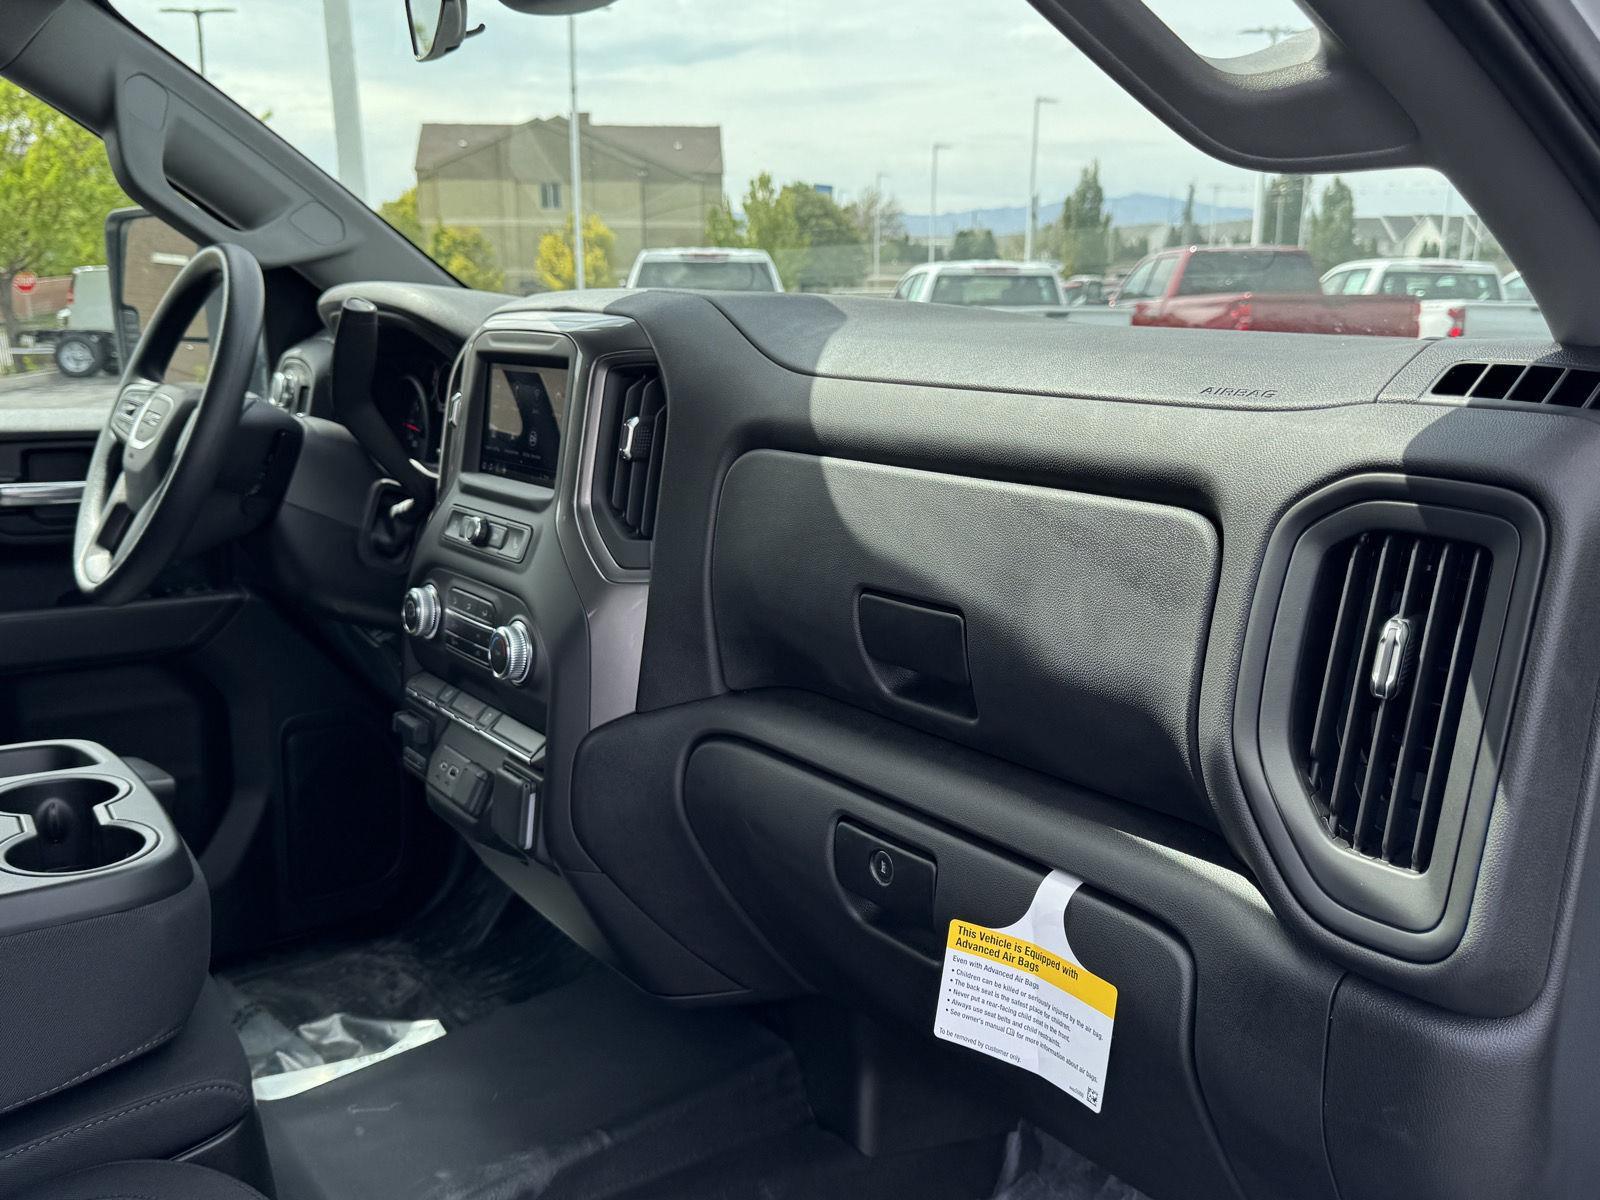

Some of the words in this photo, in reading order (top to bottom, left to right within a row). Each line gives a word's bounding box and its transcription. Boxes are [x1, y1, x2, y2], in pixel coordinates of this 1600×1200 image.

[1200, 387, 1278, 399] AIRBAG
[953, 955, 967, 964] Even
[969, 961, 982, 969] with
[984, 965, 1014, 980] Advanced
[1015, 975, 1024, 983] Air
[1025, 979, 1039, 990] Bags
[956, 938, 1000, 958] Advanced
[1002, 952, 1016, 963] Air
[1018, 957, 1039, 972] Bags
[959, 926, 977, 938] This
[980, 931, 1012, 949] Vehicle
[1014, 942, 1022, 953] is
[1025, 946, 1060, 970] Equipped
[1062, 966, 1078, 980] with
[951, 999, 971, 1010] Always
[984, 1010, 997, 1019] seat
[997, 1014, 1011, 1024] belts
[1012, 1020, 1023, 1029] and
[1024, 1024, 1037, 1034] child
[1038, 1031, 1061, 1048] restraints.
[953, 989, 969, 999] Never
[971, 995, 980, 1003] put
[986, 1000, 1017, 1016] rear-facing
[1018, 1011, 1031, 1021] child
[1033, 1018, 1044, 1027] seat
[1058, 1031, 1070, 1043] front.
[955, 979, 965, 987] The
[967, 983, 980, 991] back
[981, 988, 993, 996] seat
[1001, 994, 1010, 1002] the
[1011, 999, 1028, 1009] safest
[1029, 1005, 1043, 1016] place
[1051, 1016, 1070, 1032] children.
[956, 969, 980, 981] Children
[994, 981, 1001, 989] be
[1003, 984, 1019, 994] killed
[1028, 994, 1051, 1010] seriously
[1052, 1005, 1068, 1019] injured
[1070, 1015, 1075, 1024] by
[1093, 1029, 1103, 1041] bag.
[939, 1027, 945, 1035] To
[954, 1033, 977, 1045] removed
[978, 1040, 984, 1048] by
[985, 1044, 1009, 1057] customer
[1010, 1053, 1021, 1063] only.
[950, 1008, 961, 1017] See
[962, 1013, 984, 1025] owner's
[985, 1021, 1005, 1033] manual
[1025, 1036, 1039, 1046] more
[1040, 1041, 1065, 1061] information
[1066, 1058, 1079, 1070] about
[1086, 1070, 1098, 1083] bags.
